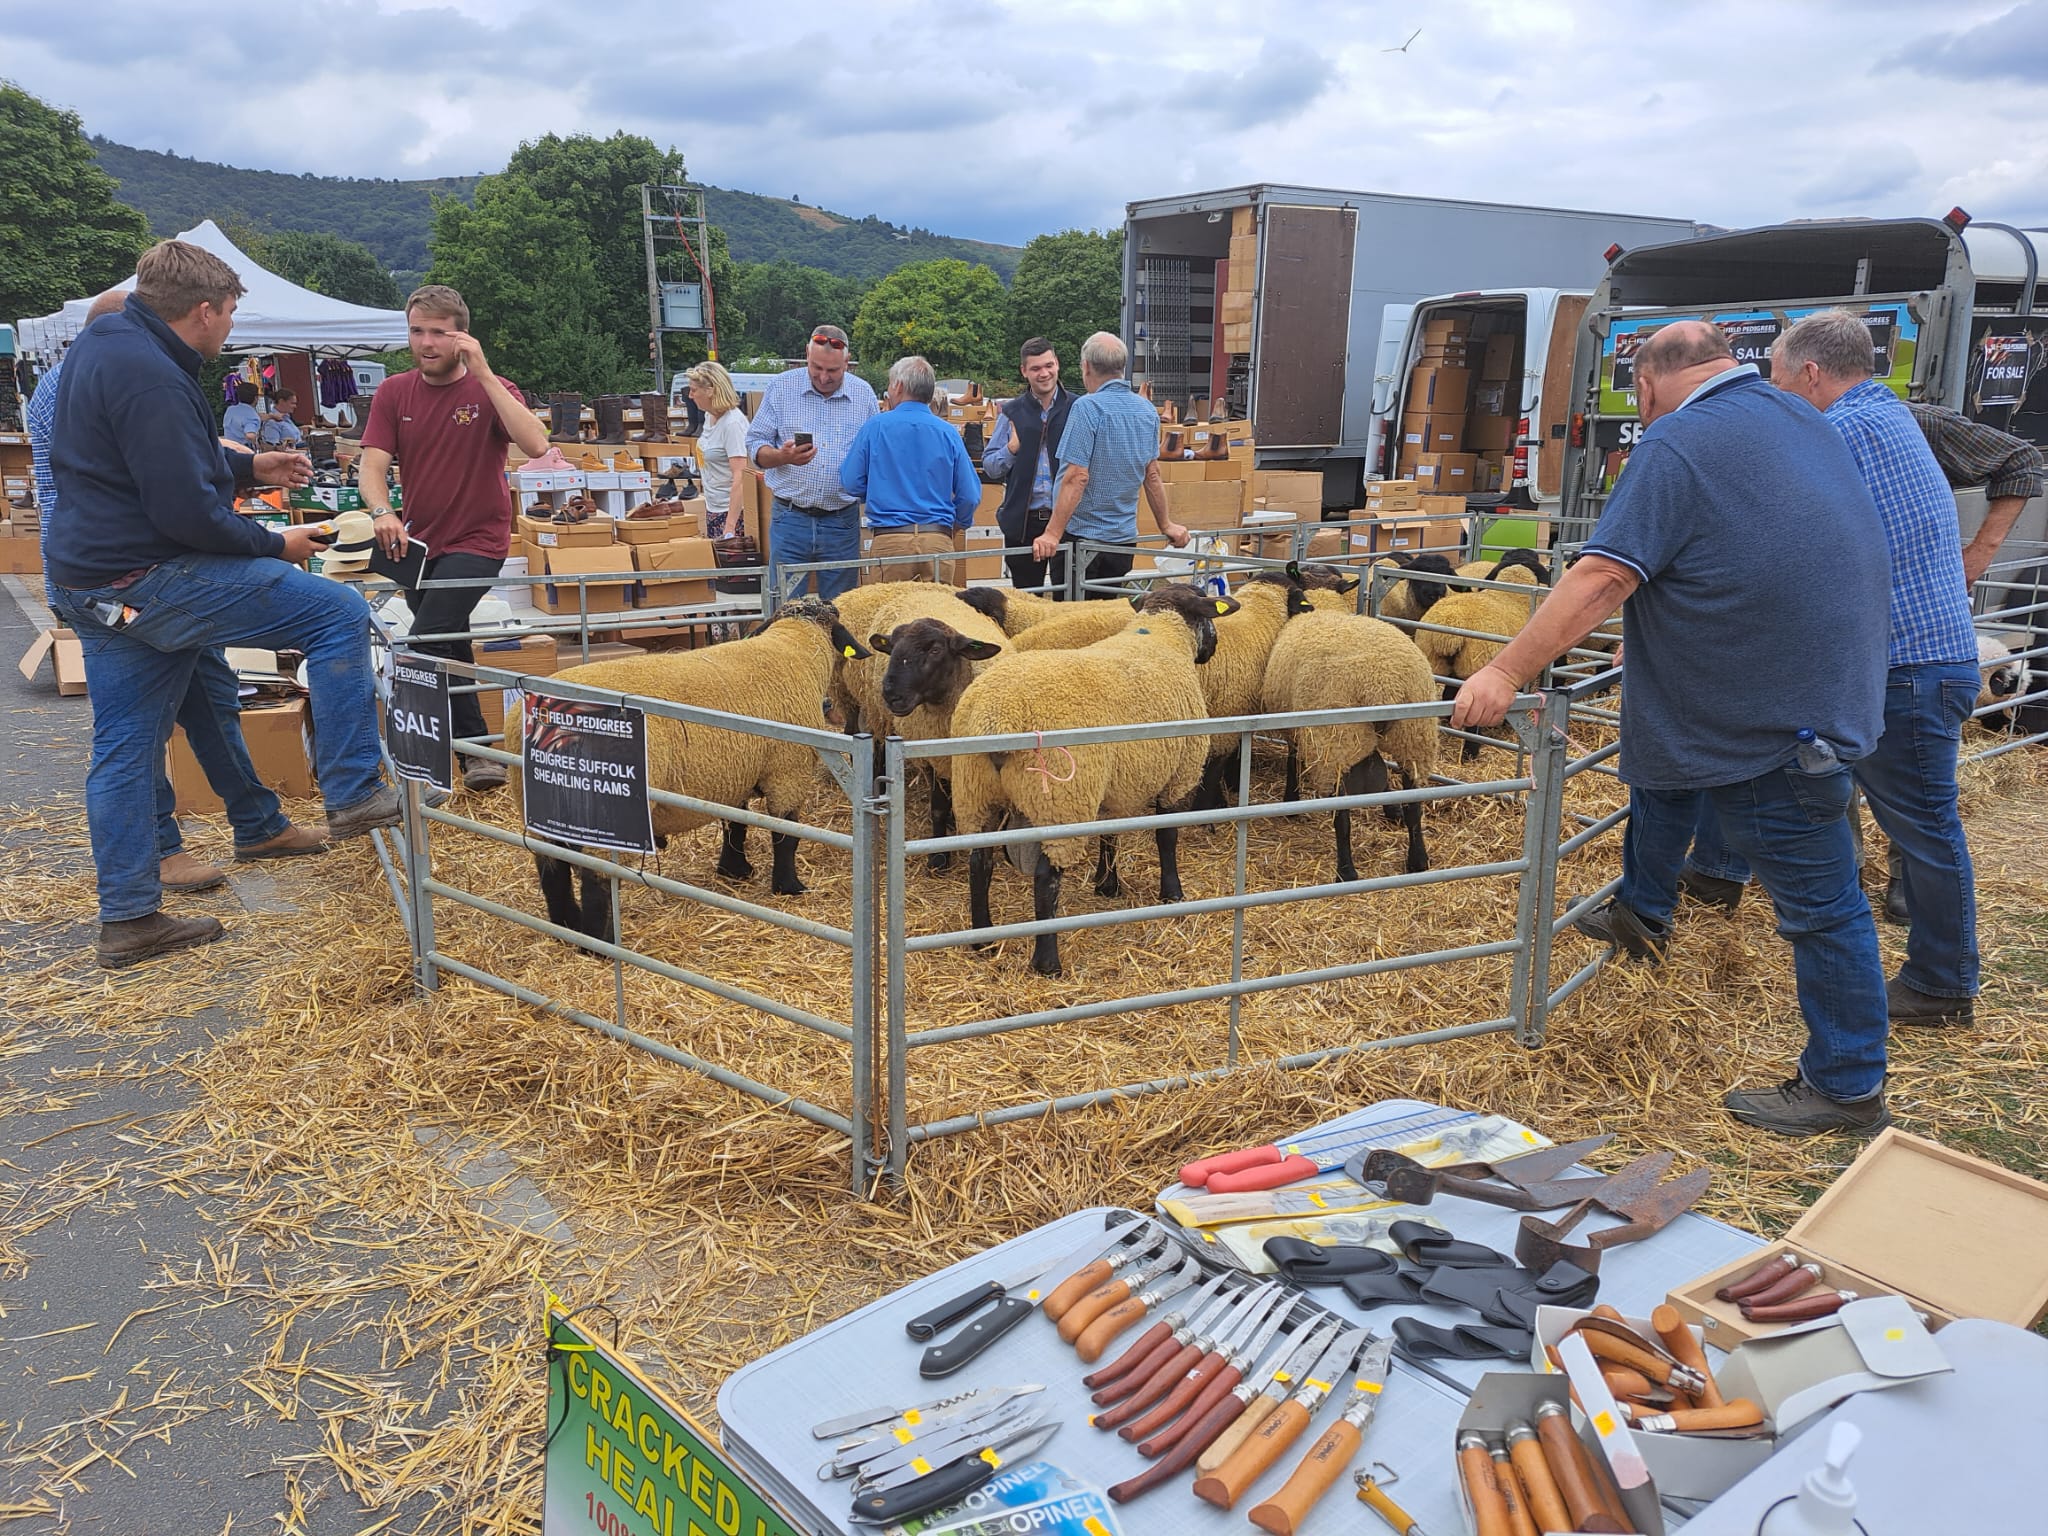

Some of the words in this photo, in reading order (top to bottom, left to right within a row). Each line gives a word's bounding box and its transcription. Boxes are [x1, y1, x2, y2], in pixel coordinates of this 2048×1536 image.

[1735, 346, 1772, 360] SALE
[1986, 367, 2005, 379] FOR
[2006, 366, 2025, 378] SALE
[395, 665, 438, 685] PEDIGREES
[393, 708, 440, 742] SALE
[575, 714, 634, 735] PEDIGREES
[530, 747, 577, 771] PEDIGREE
[578, 757, 637, 780] SUFFOLK
[533, 766, 592, 792] SHEARLING
[593, 779, 632, 798] RAMS
[568, 1351, 742, 1536] CRACKED
[965, 1461, 1049, 1511] OPINEL
[1009, 1494, 1105, 1534] OPINEL
